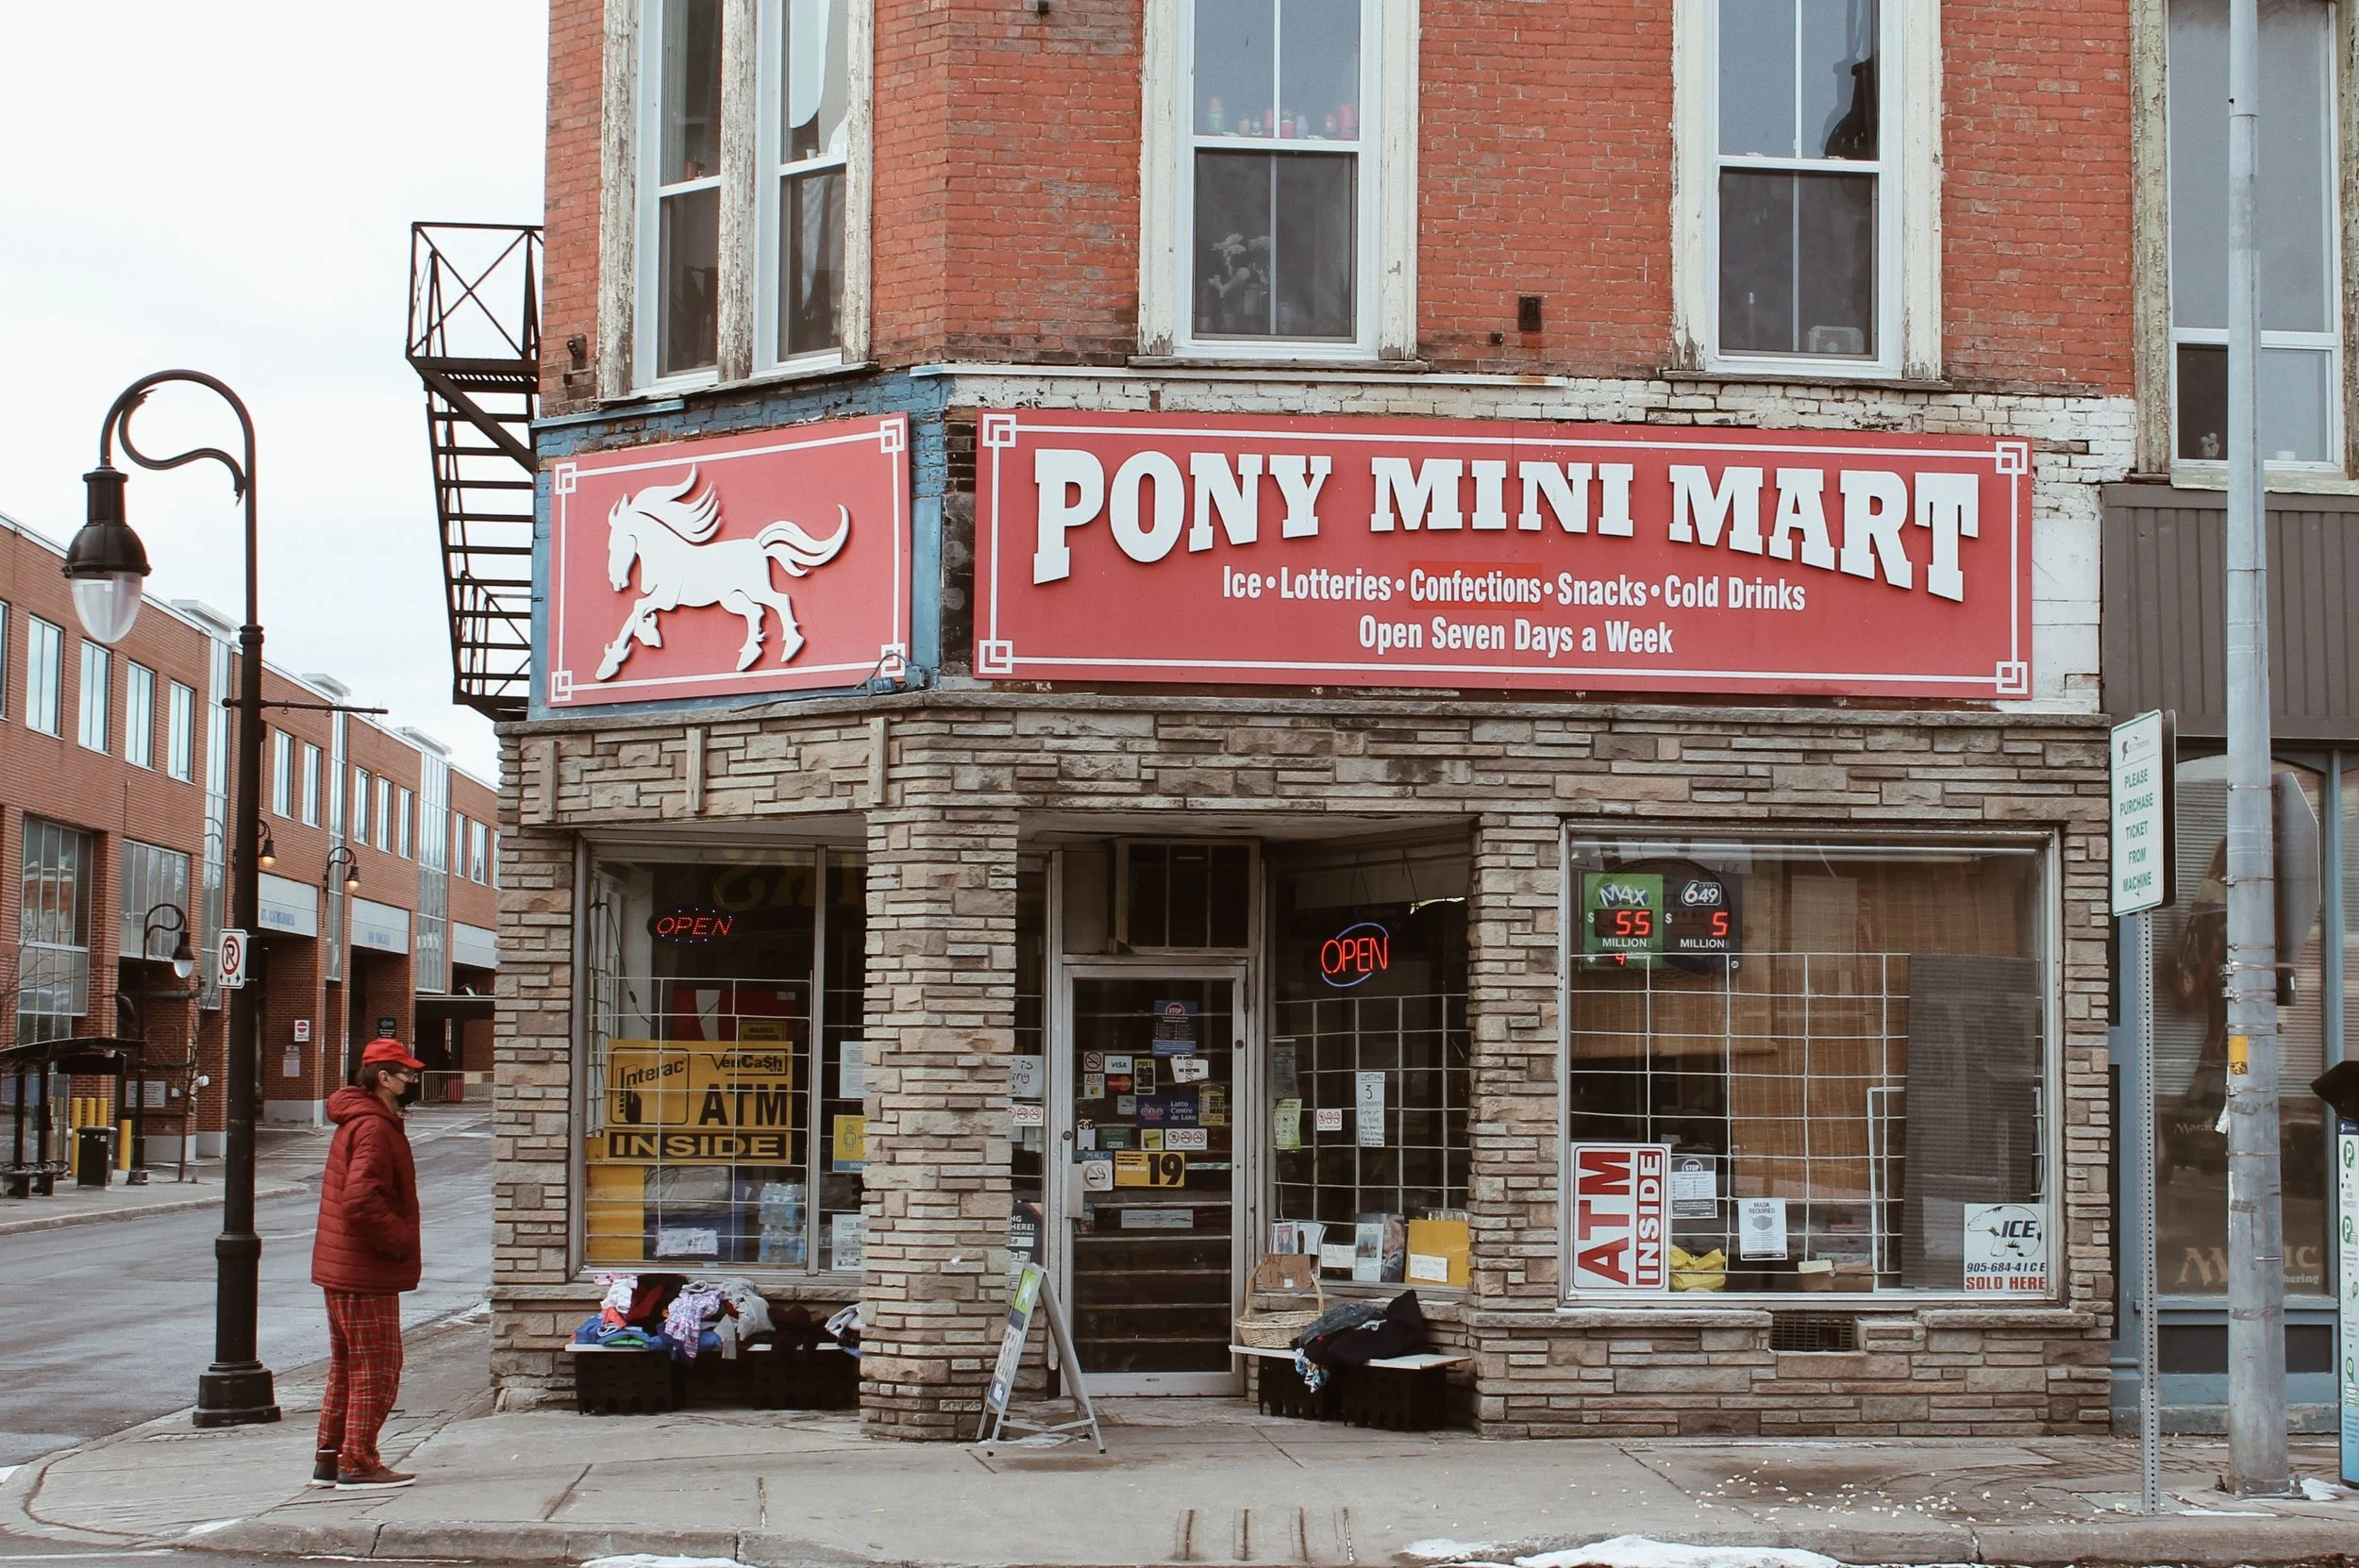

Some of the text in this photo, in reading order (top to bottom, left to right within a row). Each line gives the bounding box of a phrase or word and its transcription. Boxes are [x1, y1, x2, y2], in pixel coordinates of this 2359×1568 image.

[1033, 448, 1980, 603] PONY MINI MART
[1223, 566, 1806, 611] Ice Lotteries Confections Snacks Cold Drinks
[1359, 614, 1674, 659] Open Seven Days a Week
[2124, 767, 2149, 790] PLEASE
[2119, 792, 2153, 817] PURCHASE
[2126, 820, 2149, 842] TICKET
[2129, 847, 2147, 865] FROM
[2123, 871, 2152, 893] MACHINE
[1599, 882, 1648, 908] MAX
[657, 916, 734, 936] OPEN
[1587, 910, 1650, 935] $ 55
[1665, 910, 1729, 936] $ 5
[1321, 936, 1388, 974] OPEN
[1602, 938, 1648, 948] MILLION
[1680, 939, 1725, 949] MILLION
[620, 1053, 783, 1090] Interac VenCa$h
[1012, 1073, 1030, 1084] ing
[698, 1083, 789, 1126] ATM
[615, 1135, 780, 1157] INSIDE
[1147, 1153, 1183, 1186] 19
[1578, 1151, 1631, 1286] ATM
[1638, 1154, 1661, 1279] INSIDE
[2000, 1220, 2037, 1239] ICE
[2174, 1246, 2321, 1287] MIC
[1966, 1276, 2046, 1290] SOLD HERE
[2283, 1274, 2320, 1286] hering
